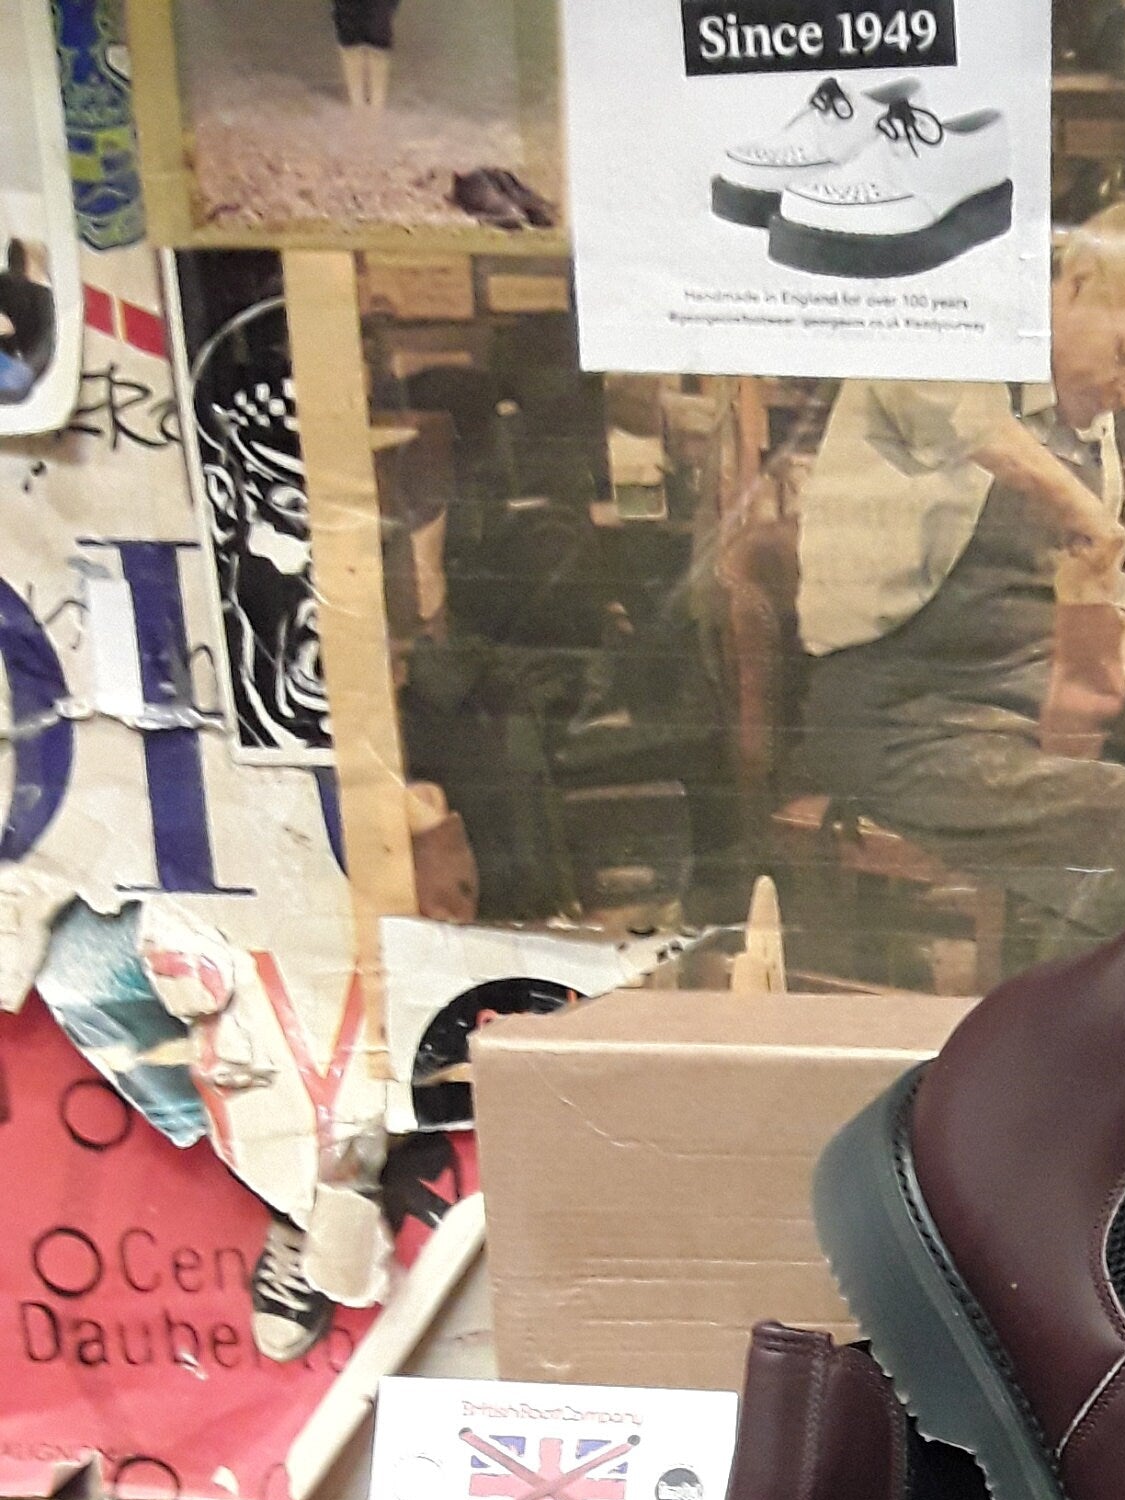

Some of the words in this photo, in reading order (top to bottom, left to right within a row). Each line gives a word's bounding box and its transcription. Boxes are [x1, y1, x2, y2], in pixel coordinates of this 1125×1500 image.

[700, 12, 824, 58] Since
[836, 8, 938, 54] 1949
[903, 293, 928, 307] 100
[119, 1228, 250, 1293] Cen
